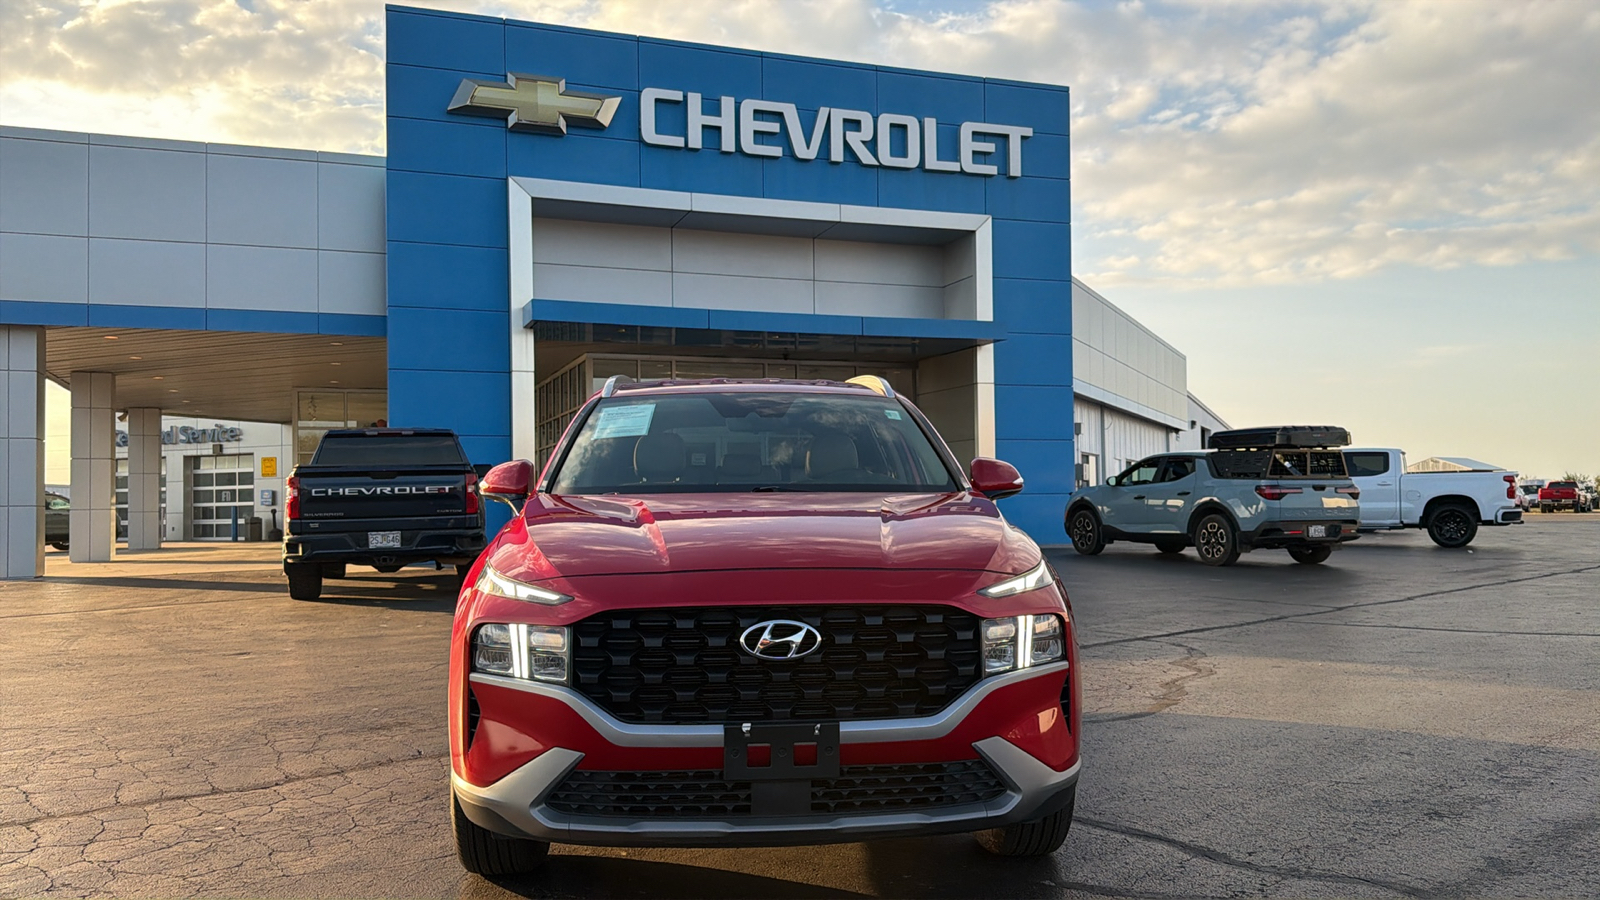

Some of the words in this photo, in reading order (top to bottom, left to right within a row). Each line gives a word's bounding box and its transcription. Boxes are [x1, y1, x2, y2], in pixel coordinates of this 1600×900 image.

[640, 87, 1034, 178] CHEVROLET
[179, 424, 243, 444] Service
[311, 485, 455, 497] CHEVROLET
